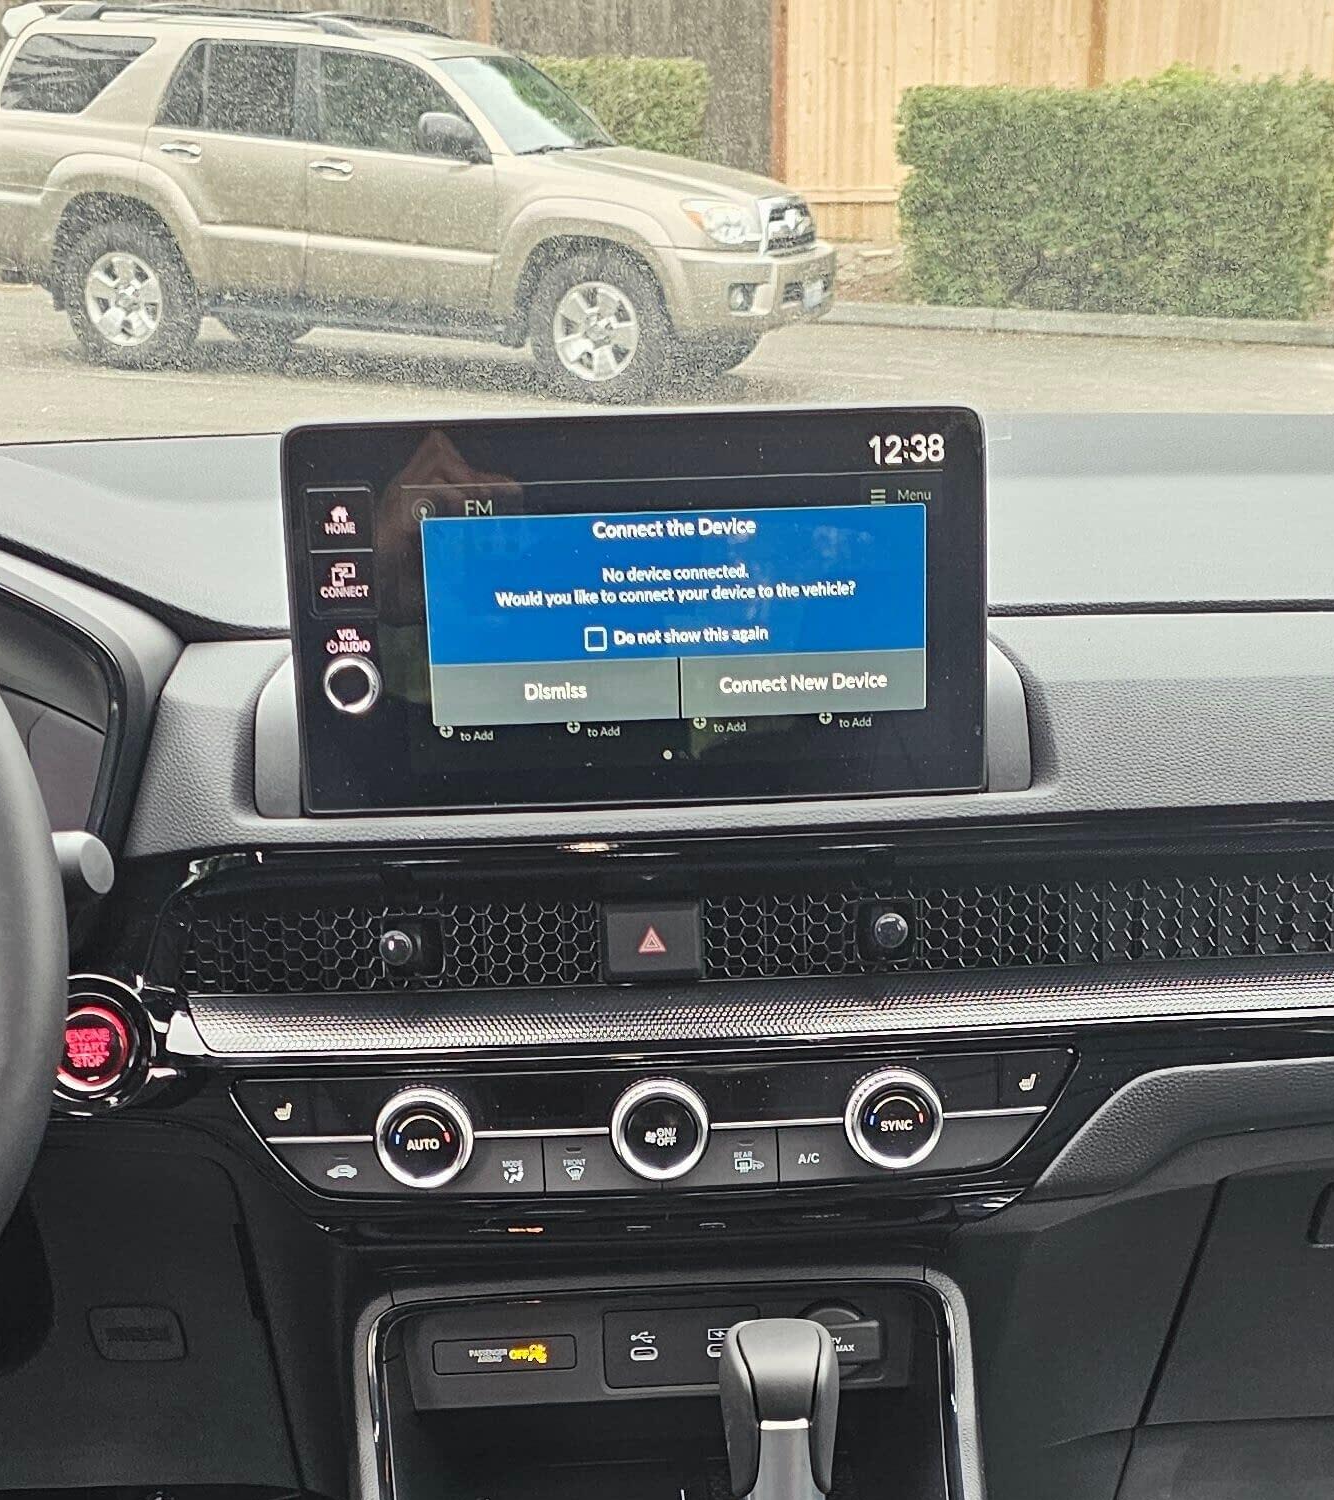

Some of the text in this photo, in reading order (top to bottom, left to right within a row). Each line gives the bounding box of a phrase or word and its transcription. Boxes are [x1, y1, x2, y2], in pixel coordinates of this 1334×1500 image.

[868, 433, 945, 466] 12:38
[897, 489, 932, 502] Menu
[465, 500, 493, 516] FM
[324, 523, 356, 535] HOME
[592, 517, 757, 539] Connect the Device
[602, 564, 749, 583] No device connected.
[320, 585, 369, 599] CONNECT
[495, 580, 857, 608] Would you like to connect your device to the vehicle?
[337, 629, 360, 641] VOL
[613, 626, 769, 645] Do not show this again
[338, 640, 371, 653] AUDIO
[719, 672, 888, 694] Connect New Device
[524, 682, 588, 701] Dismiss
[713, 721, 747, 733] to Add
[839, 717, 872, 729] to Add
[460, 730, 494, 742] to Add
[587, 726, 621, 738] to Add
[66, 1028, 110, 1042] ENGINE
[69, 1042, 107, 1053] START
[72, 1056, 105, 1067] STOP
[880, 1119, 913, 1132] SYNC
[406, 1138, 440, 1151] AUTO
[656, 1136, 677, 1147] OFF
[502, 1160, 523, 1168] MODE
[562, 1158, 586, 1166] FRONT
[798, 1152, 820, 1165] A/C
